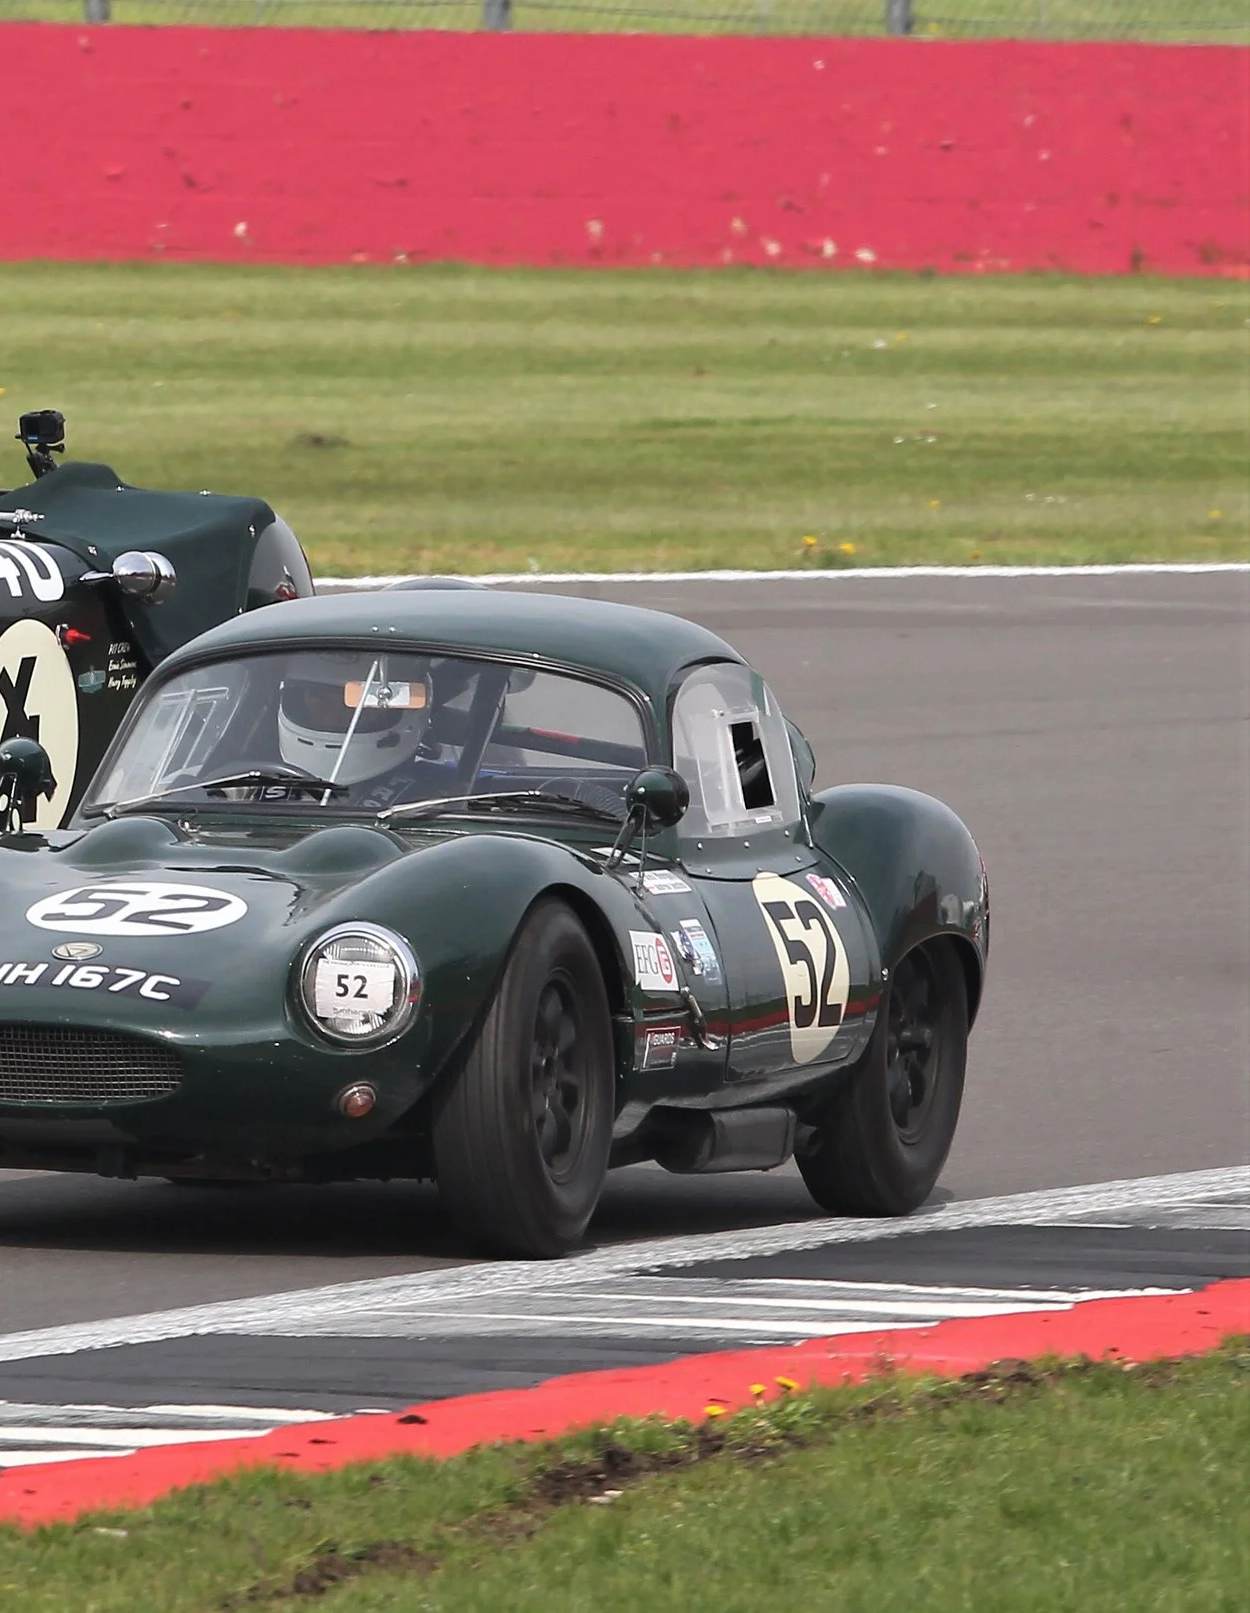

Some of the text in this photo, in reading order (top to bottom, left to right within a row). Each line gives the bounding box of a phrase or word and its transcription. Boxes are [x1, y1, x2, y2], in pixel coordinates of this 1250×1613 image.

[41, 889, 233, 930] 52
[635, 944, 659, 975] EFG
[762, 900, 842, 1028] 52
[49, 963, 181, 1001] 167C
[335, 974, 368, 998] 52
